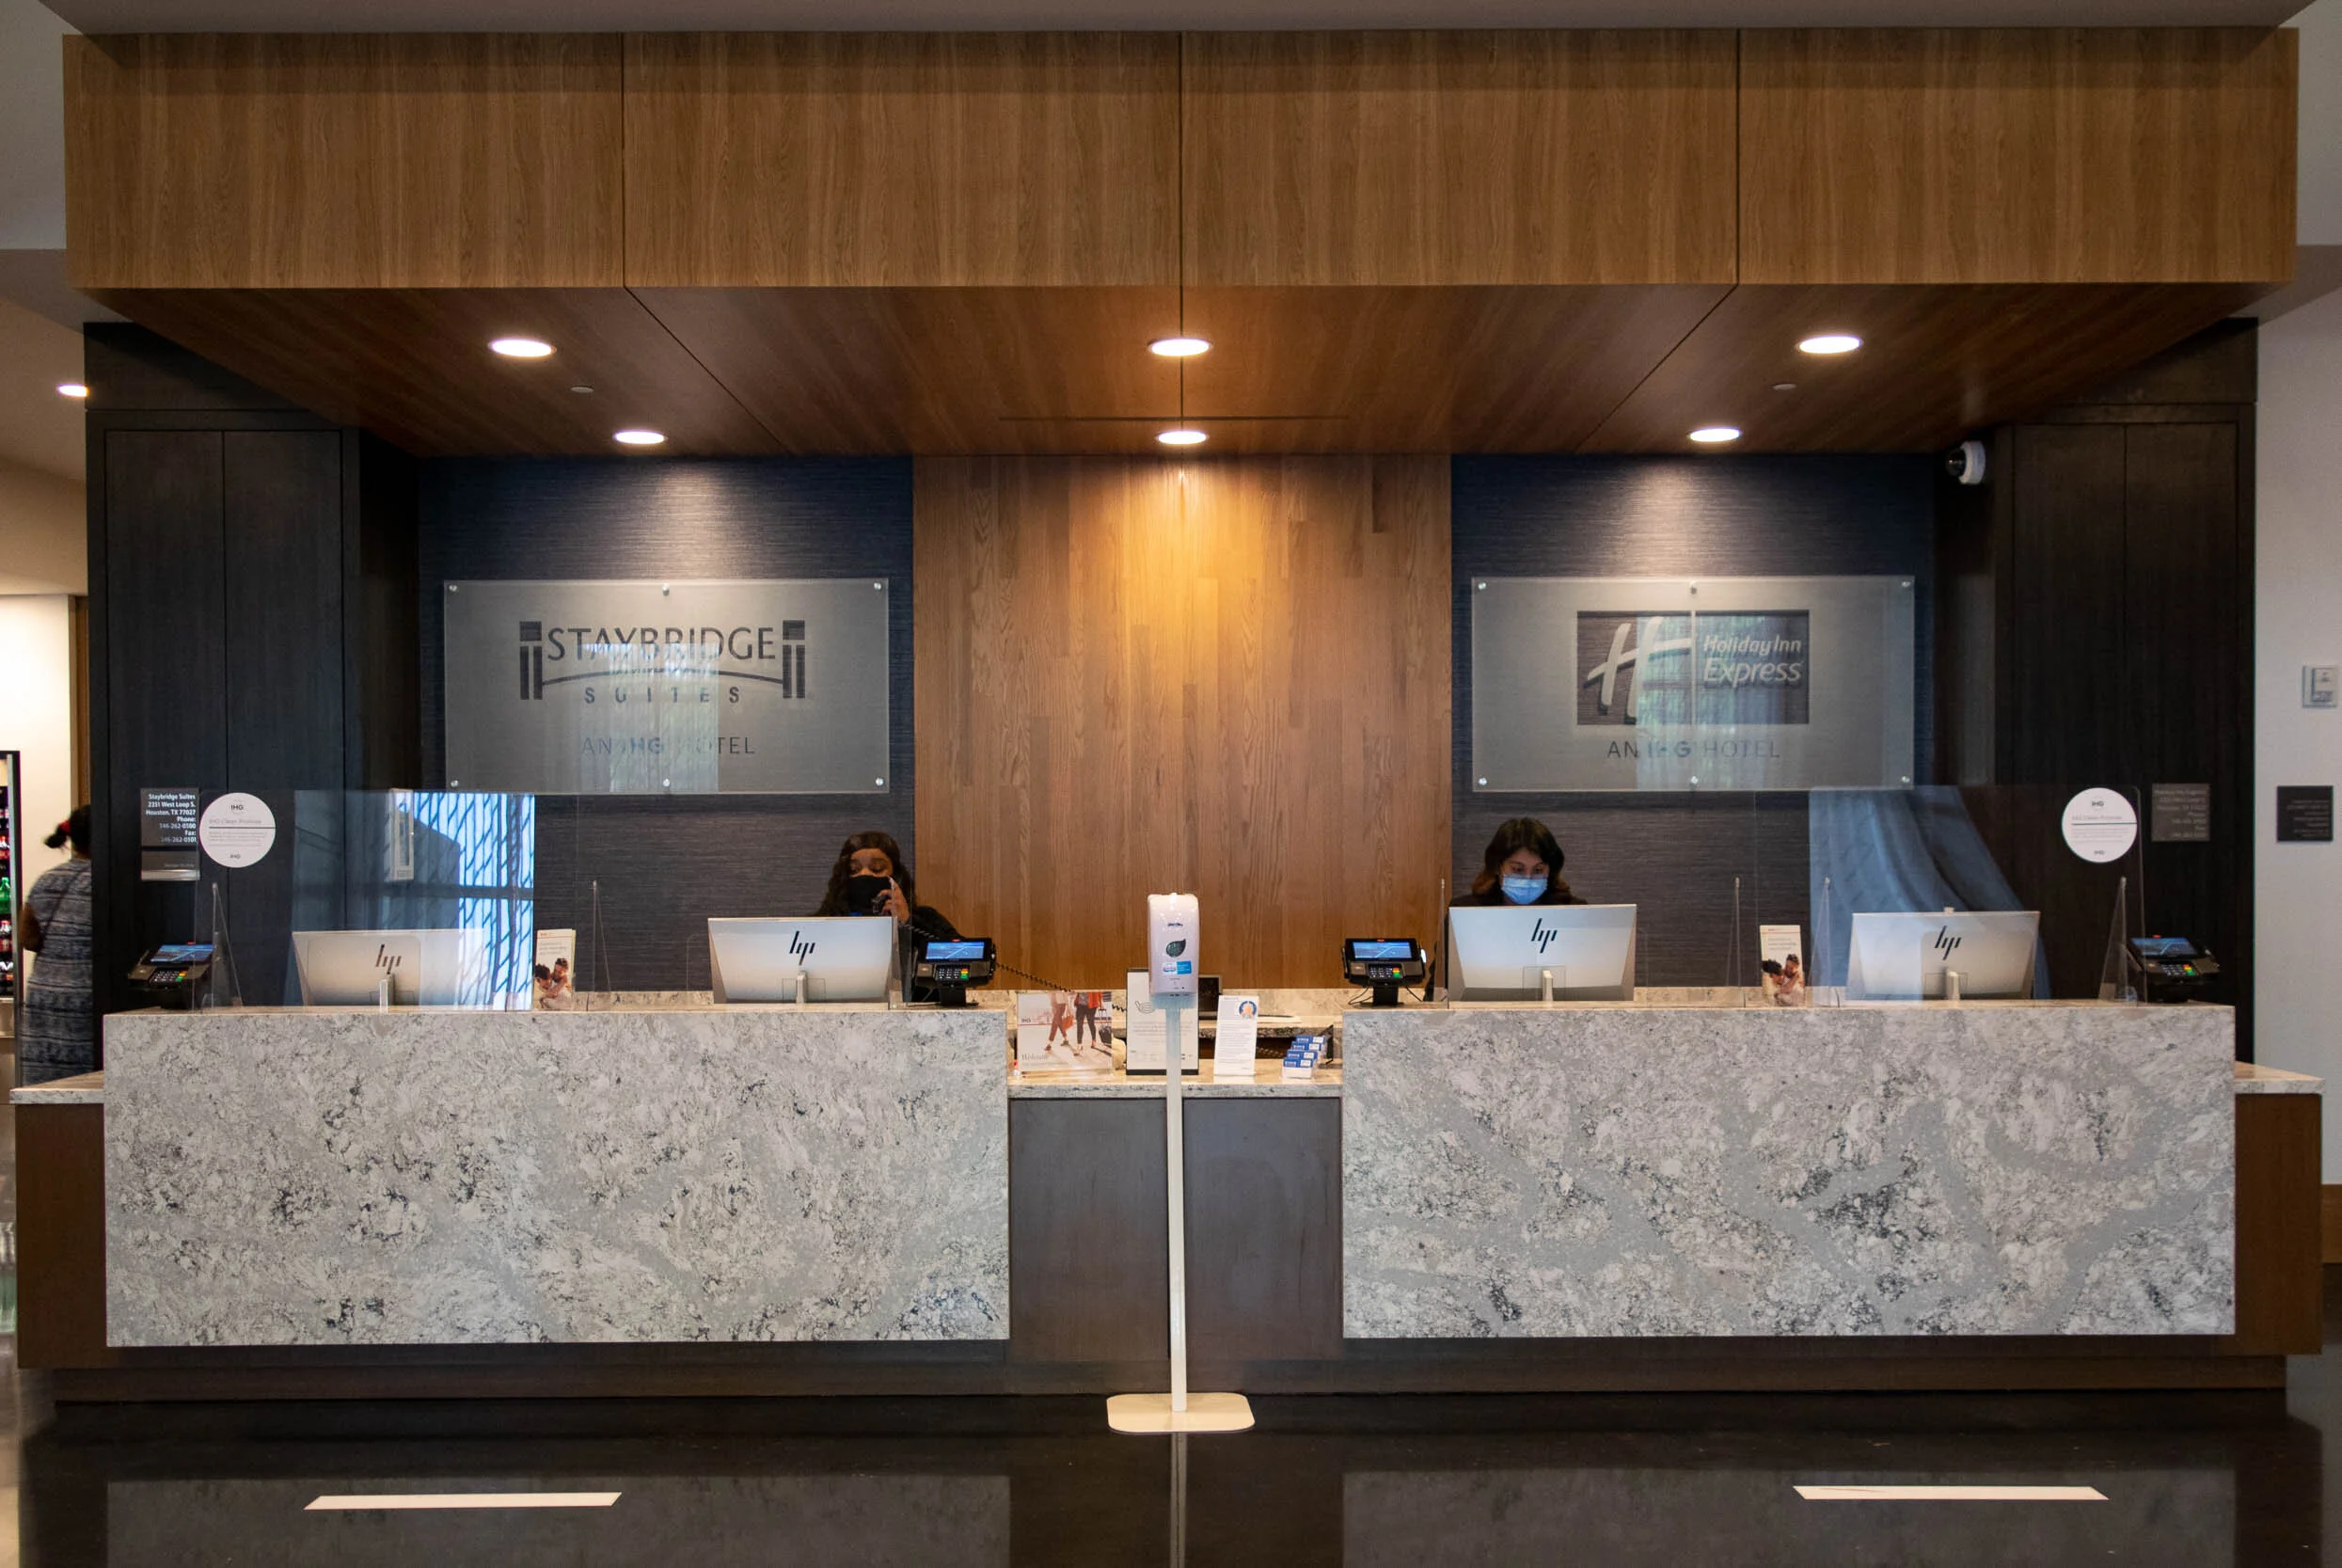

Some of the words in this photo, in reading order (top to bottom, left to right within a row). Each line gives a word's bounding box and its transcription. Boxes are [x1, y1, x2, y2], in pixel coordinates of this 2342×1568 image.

[547, 626, 777, 662] STAYBRIDGE
[1703, 635, 1773, 656] Holiday
[1774, 635, 1801, 653] Inn
[1703, 657, 1802, 689] Express
[584, 686, 740, 705] SUITES
[581, 736, 611, 754] AN
[677, 736, 755, 754] OTEL
[1606, 740, 1638, 758] AN
[1703, 740, 1780, 758] HOTEL
[789, 930, 816, 965] hp
[1530, 918, 1558, 954] hp
[1934, 925, 1962, 960] hp
[375, 943, 402, 975] hp
